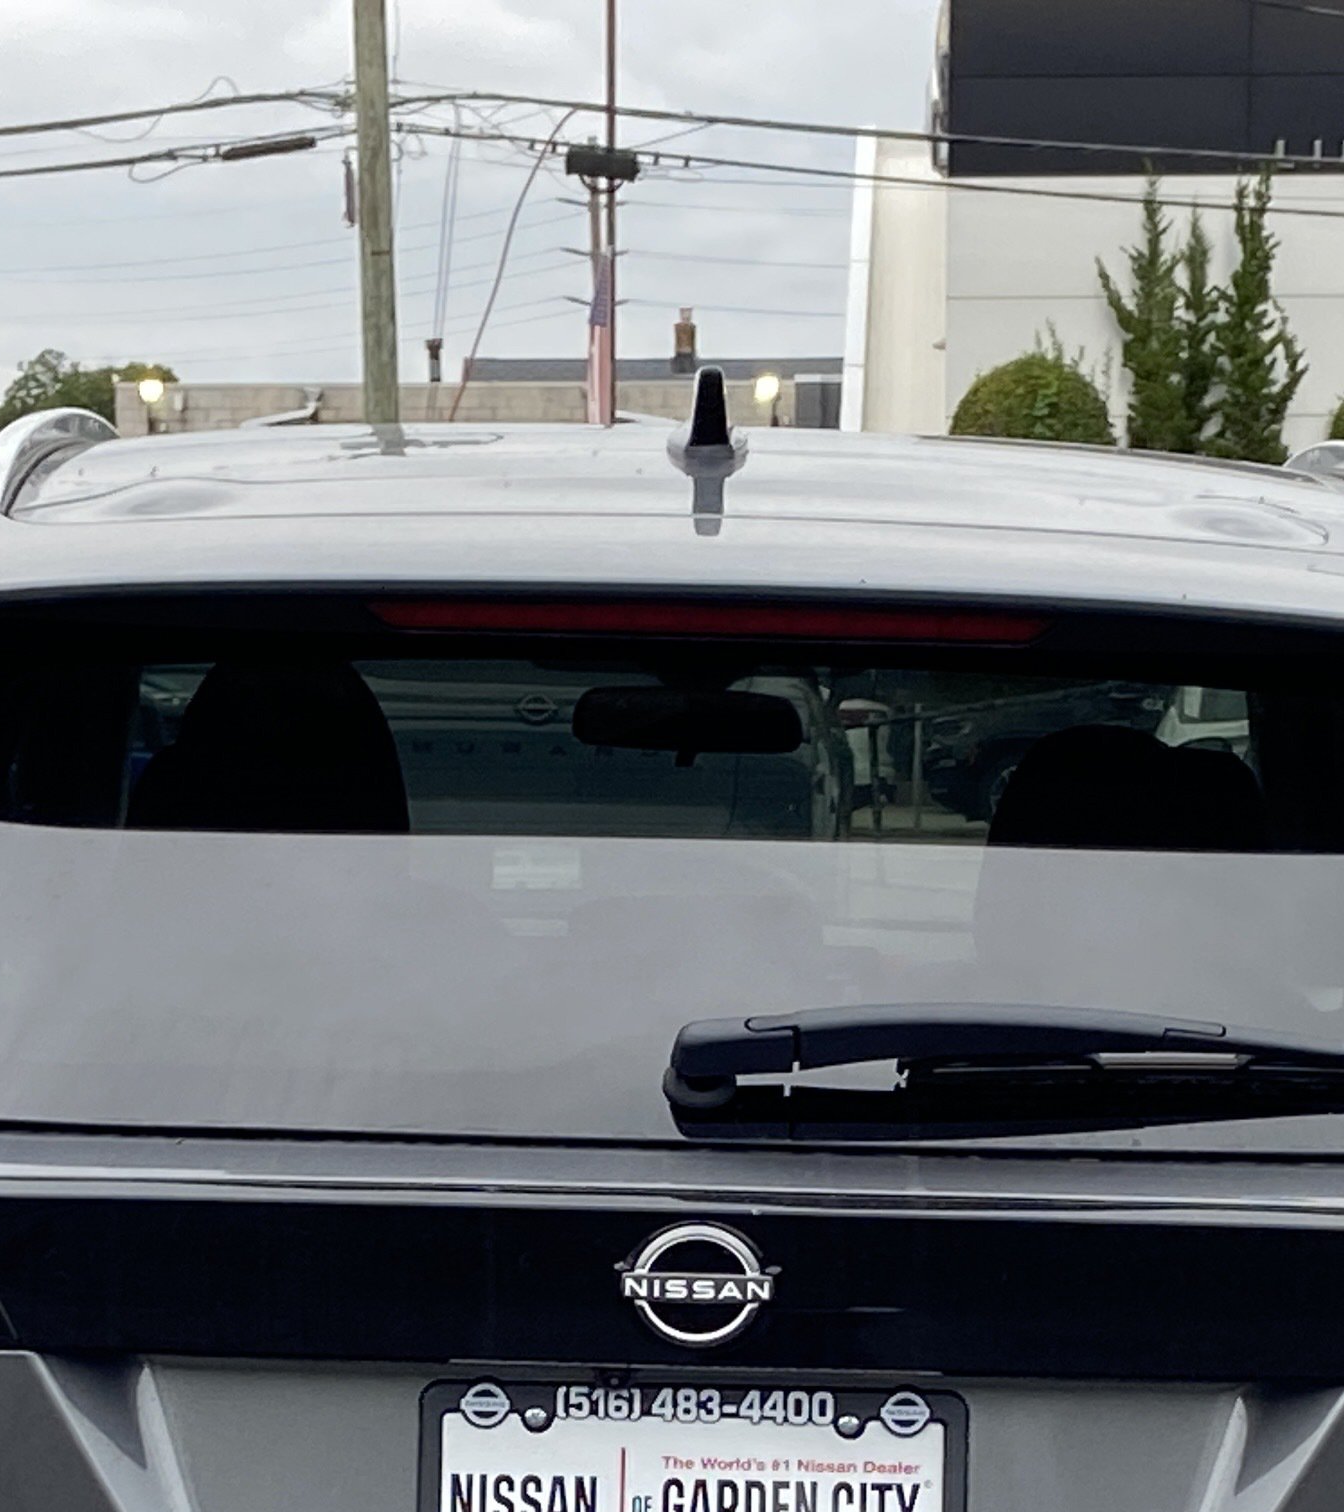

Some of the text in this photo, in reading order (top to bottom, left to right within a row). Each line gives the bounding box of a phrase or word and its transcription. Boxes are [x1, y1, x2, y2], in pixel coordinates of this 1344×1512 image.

[624, 1277, 770, 1300] NISSAN
[556, 1385, 835, 1426] (516) 483-4400
[661, 1455, 694, 1470] The
[700, 1457, 766, 1472] World's
[797, 1459, 857, 1473] Nissan
[863, 1460, 921, 1475] Dealer
